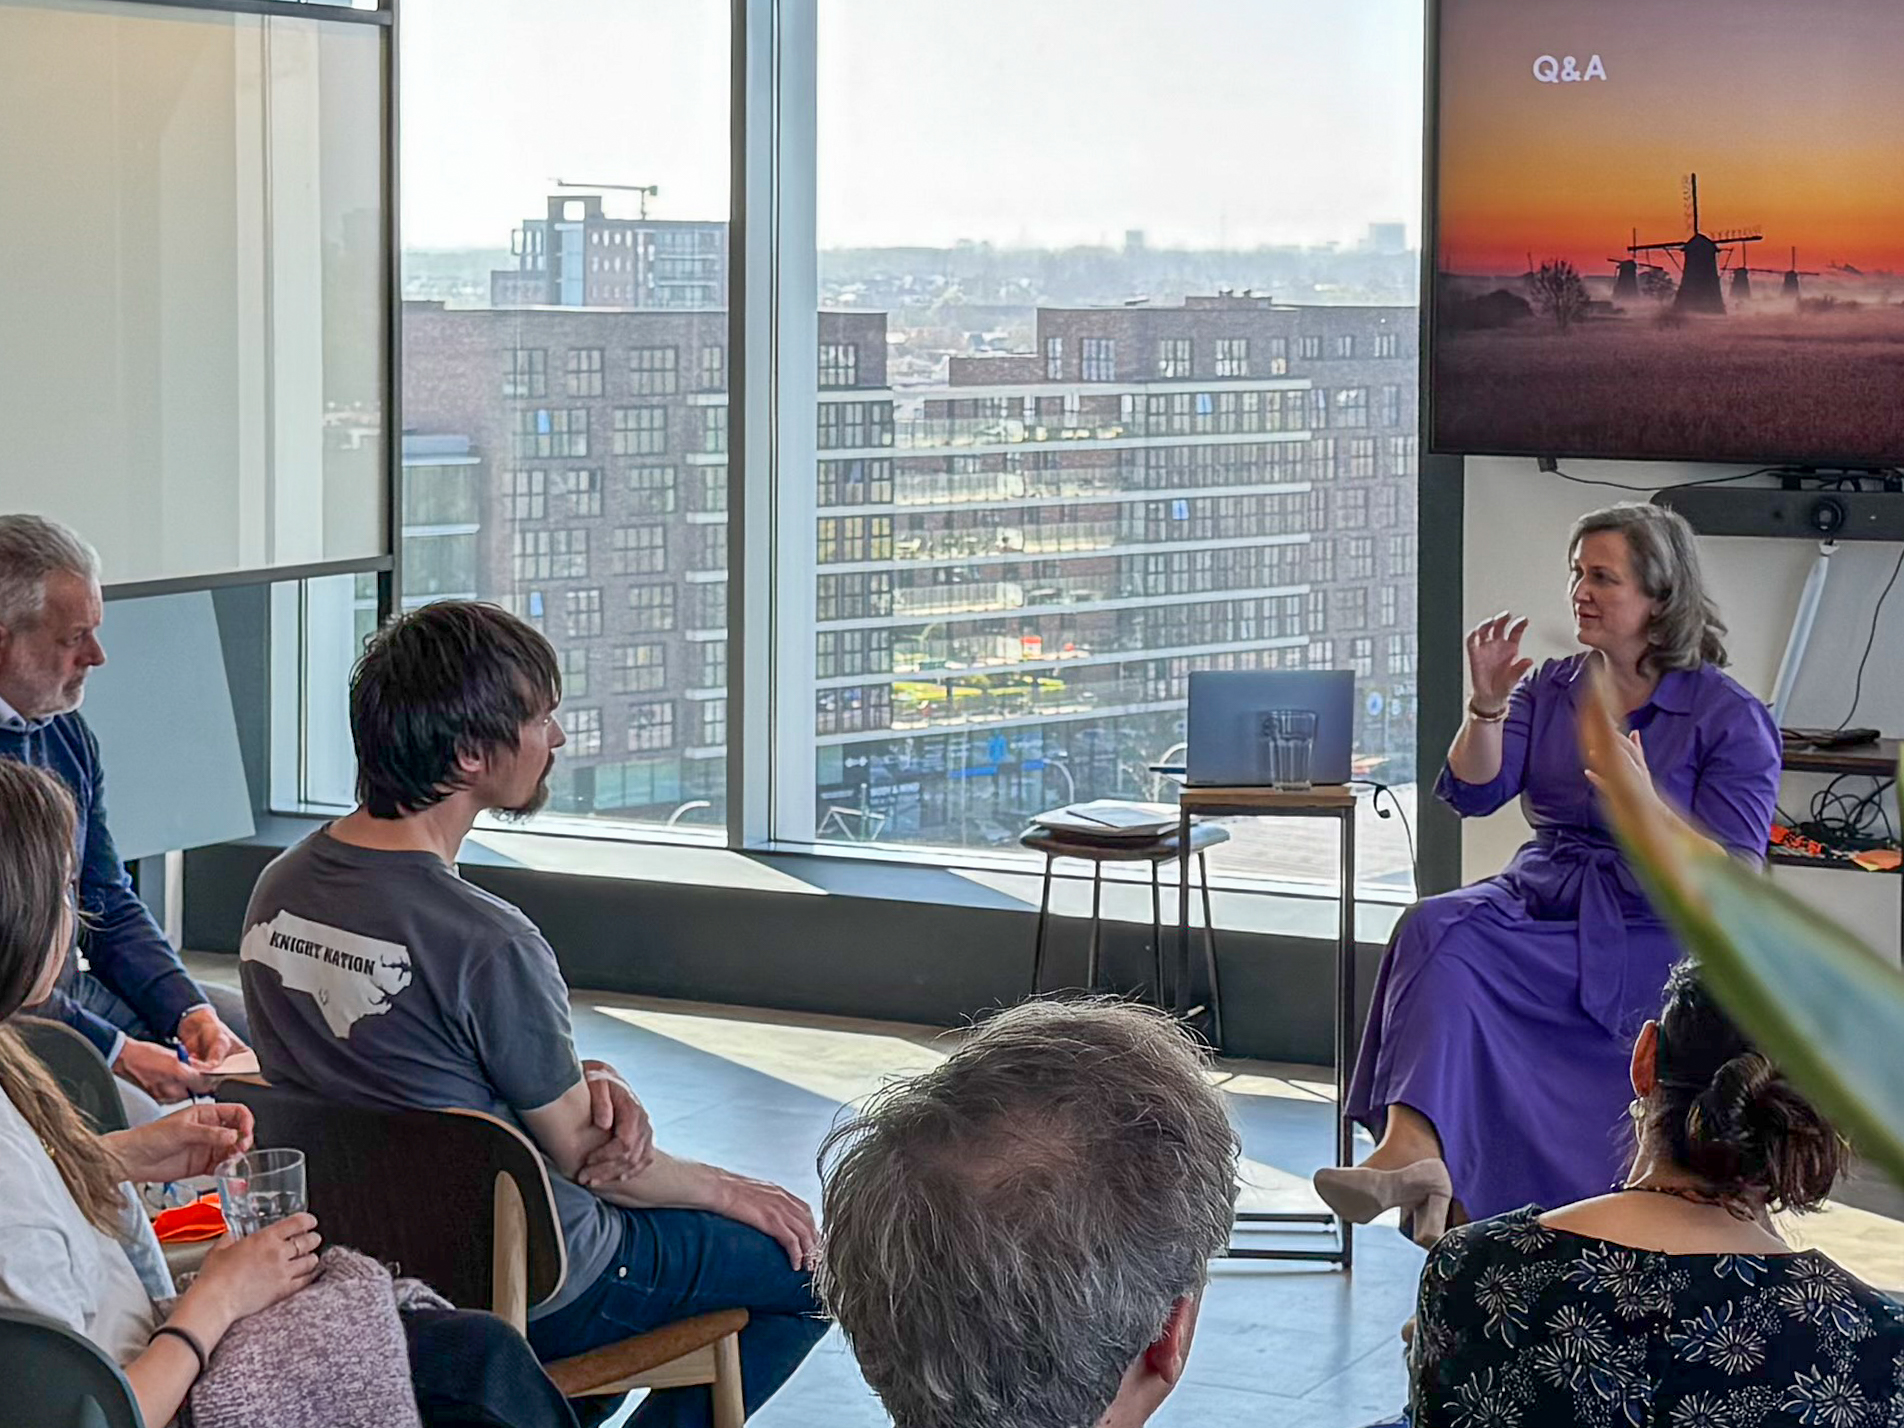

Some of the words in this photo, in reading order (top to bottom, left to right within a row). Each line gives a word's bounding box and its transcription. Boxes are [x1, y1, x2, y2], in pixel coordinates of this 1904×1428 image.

[1533, 54, 1607, 83] Q&A
[269, 931, 324, 960] KNIGHT
[323, 945, 376, 976] NATION
